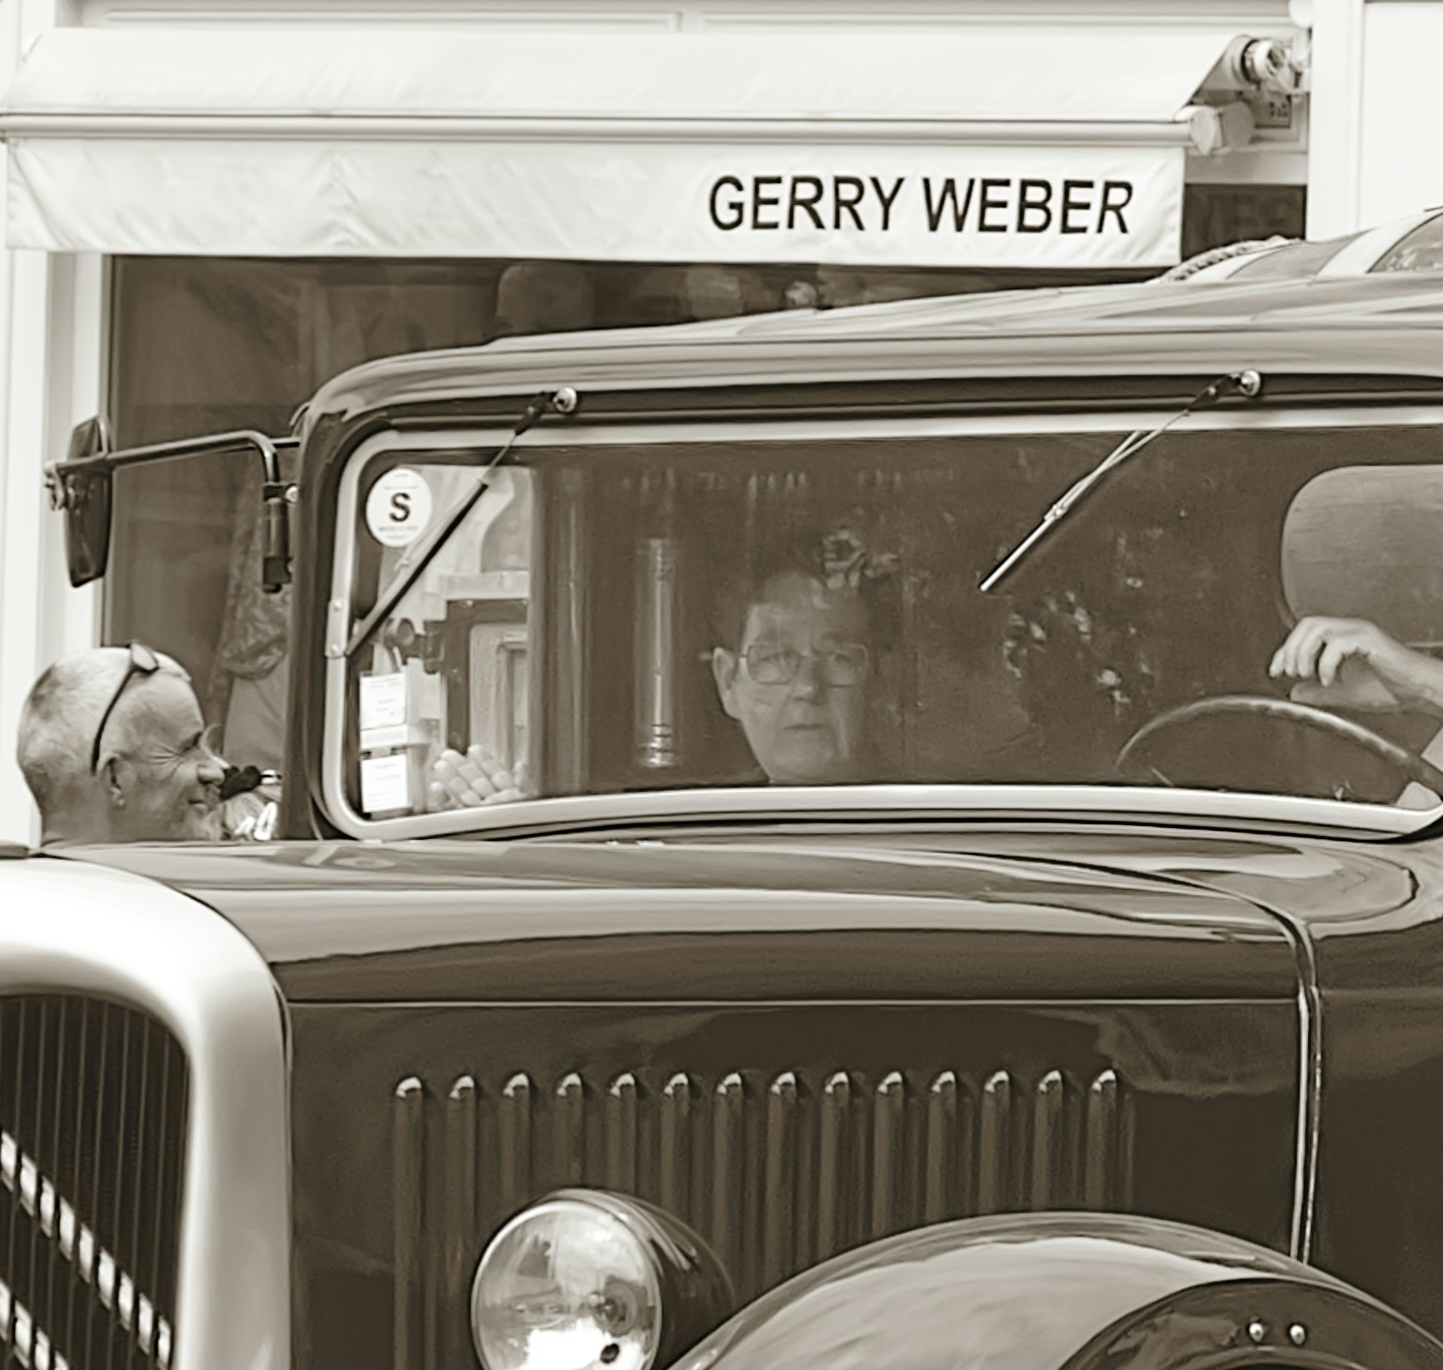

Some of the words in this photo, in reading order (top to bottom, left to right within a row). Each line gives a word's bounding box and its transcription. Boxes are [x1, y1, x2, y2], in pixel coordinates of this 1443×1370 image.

[709, 175, 905, 231] GERRY
[922, 177, 1133, 234] WEBER
[389, 491, 411, 523] S
